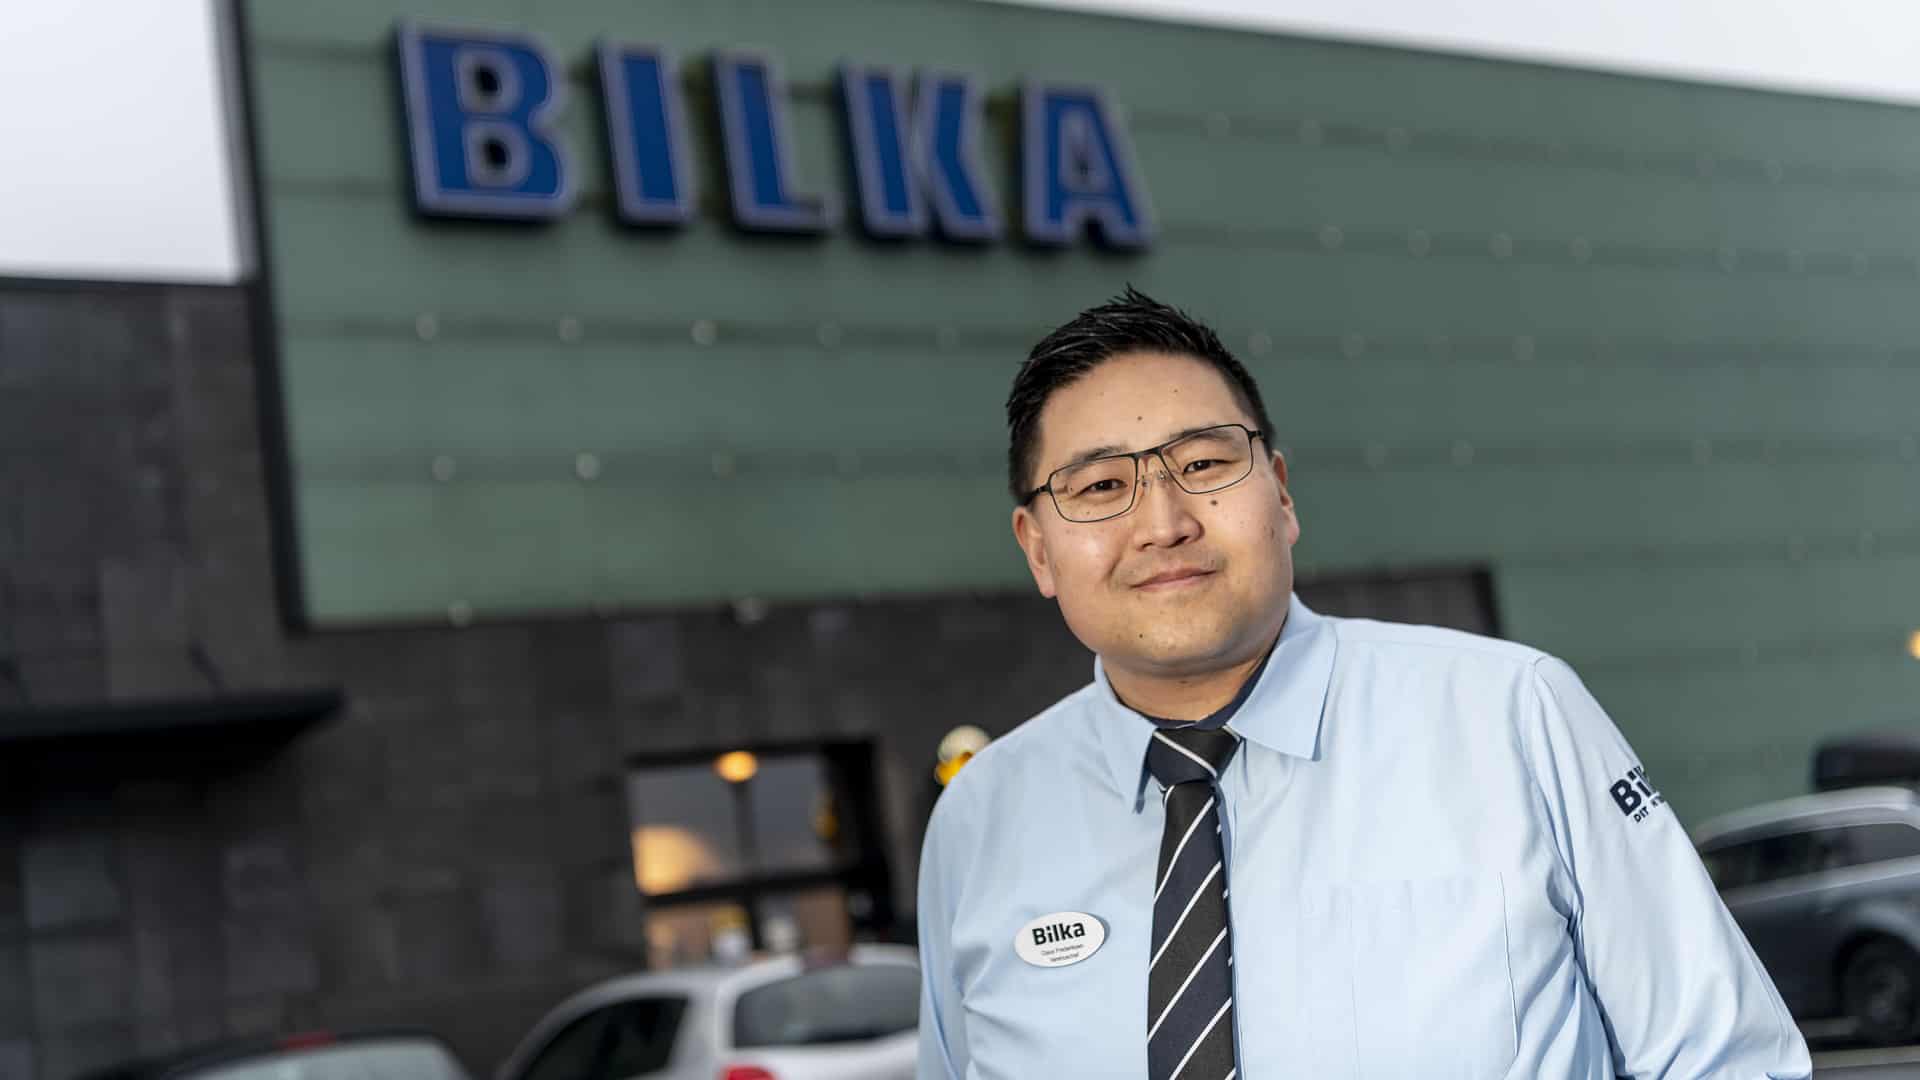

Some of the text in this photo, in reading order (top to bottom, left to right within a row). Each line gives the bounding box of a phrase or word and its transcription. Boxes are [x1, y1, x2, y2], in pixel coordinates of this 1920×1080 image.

[397, 20, 1152, 250] BILKA
[1633, 806, 1649, 823] DIT
[1031, 922, 1086, 946] Bilka
